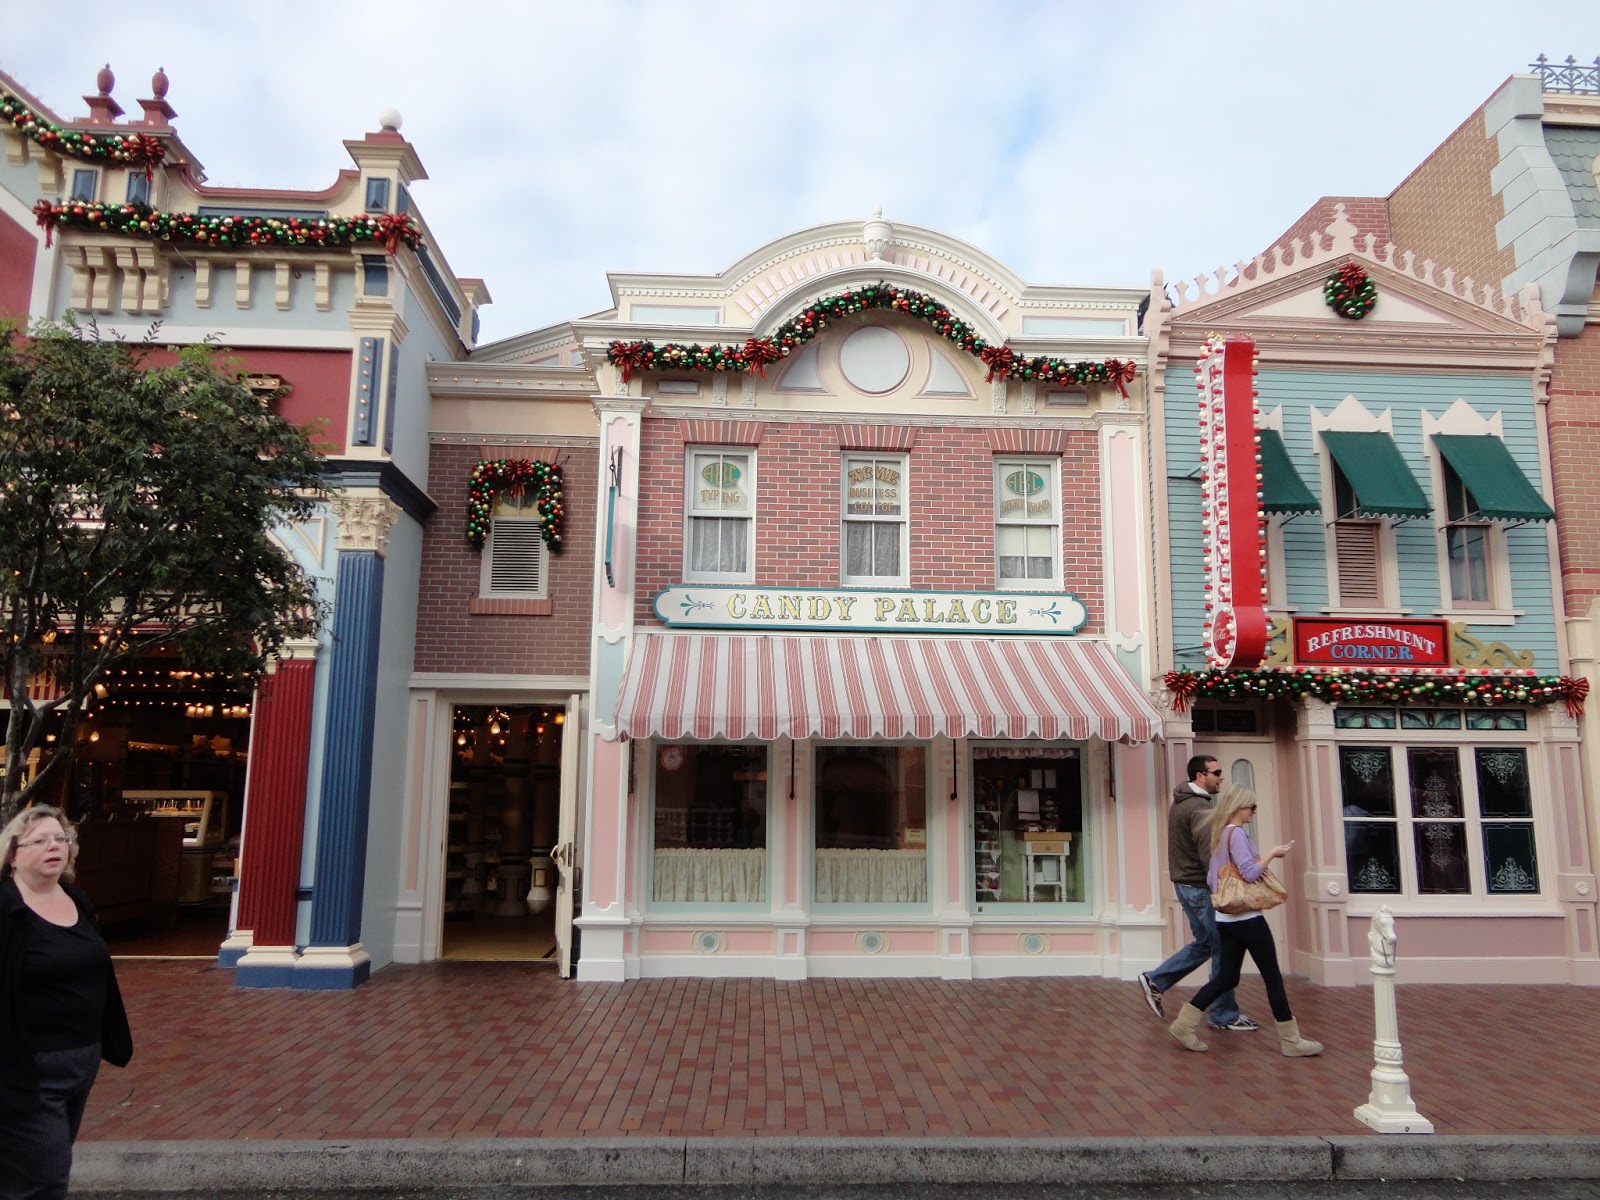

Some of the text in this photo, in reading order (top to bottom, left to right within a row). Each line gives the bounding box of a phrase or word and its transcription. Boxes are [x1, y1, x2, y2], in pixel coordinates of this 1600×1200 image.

[703, 463, 740, 484] ABC
[848, 466, 900, 485] ACME
[1007, 471, 1043, 494] ABC
[726, 593, 1018, 624] CANDY PALACE
[1307, 625, 1436, 655] REFRESHMENT
[1330, 644, 1414, 660] CORNER
